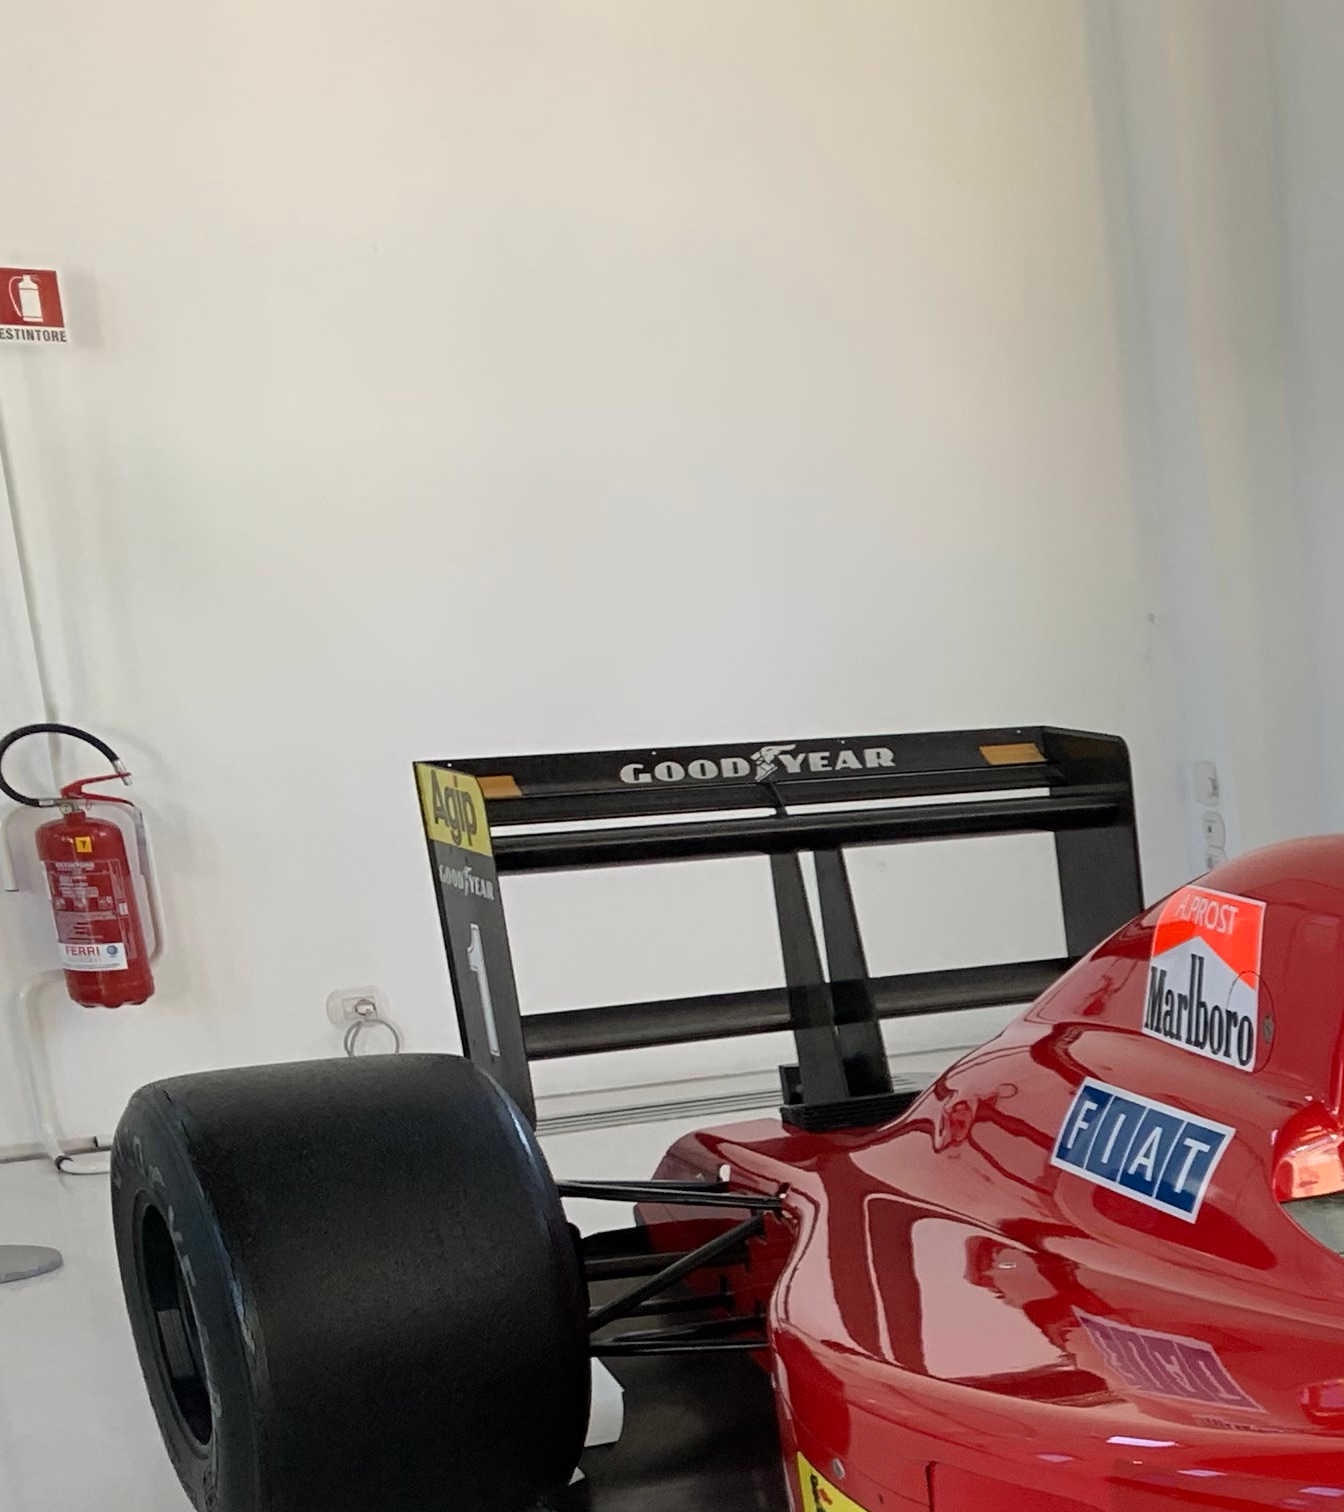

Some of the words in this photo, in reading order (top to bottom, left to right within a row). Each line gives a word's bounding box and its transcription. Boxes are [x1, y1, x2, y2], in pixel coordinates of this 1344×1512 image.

[0, 327, 67, 342] ESTINTORE
[620, 744, 896, 785] GOODYEAR
[431, 770, 477, 846] Agip
[439, 862, 494, 901] GOODYEAR
[467, 923, 500, 1056] 1
[1145, 953, 1253, 1066] Marlboro
[1067, 1102, 1210, 1193] FIAT
